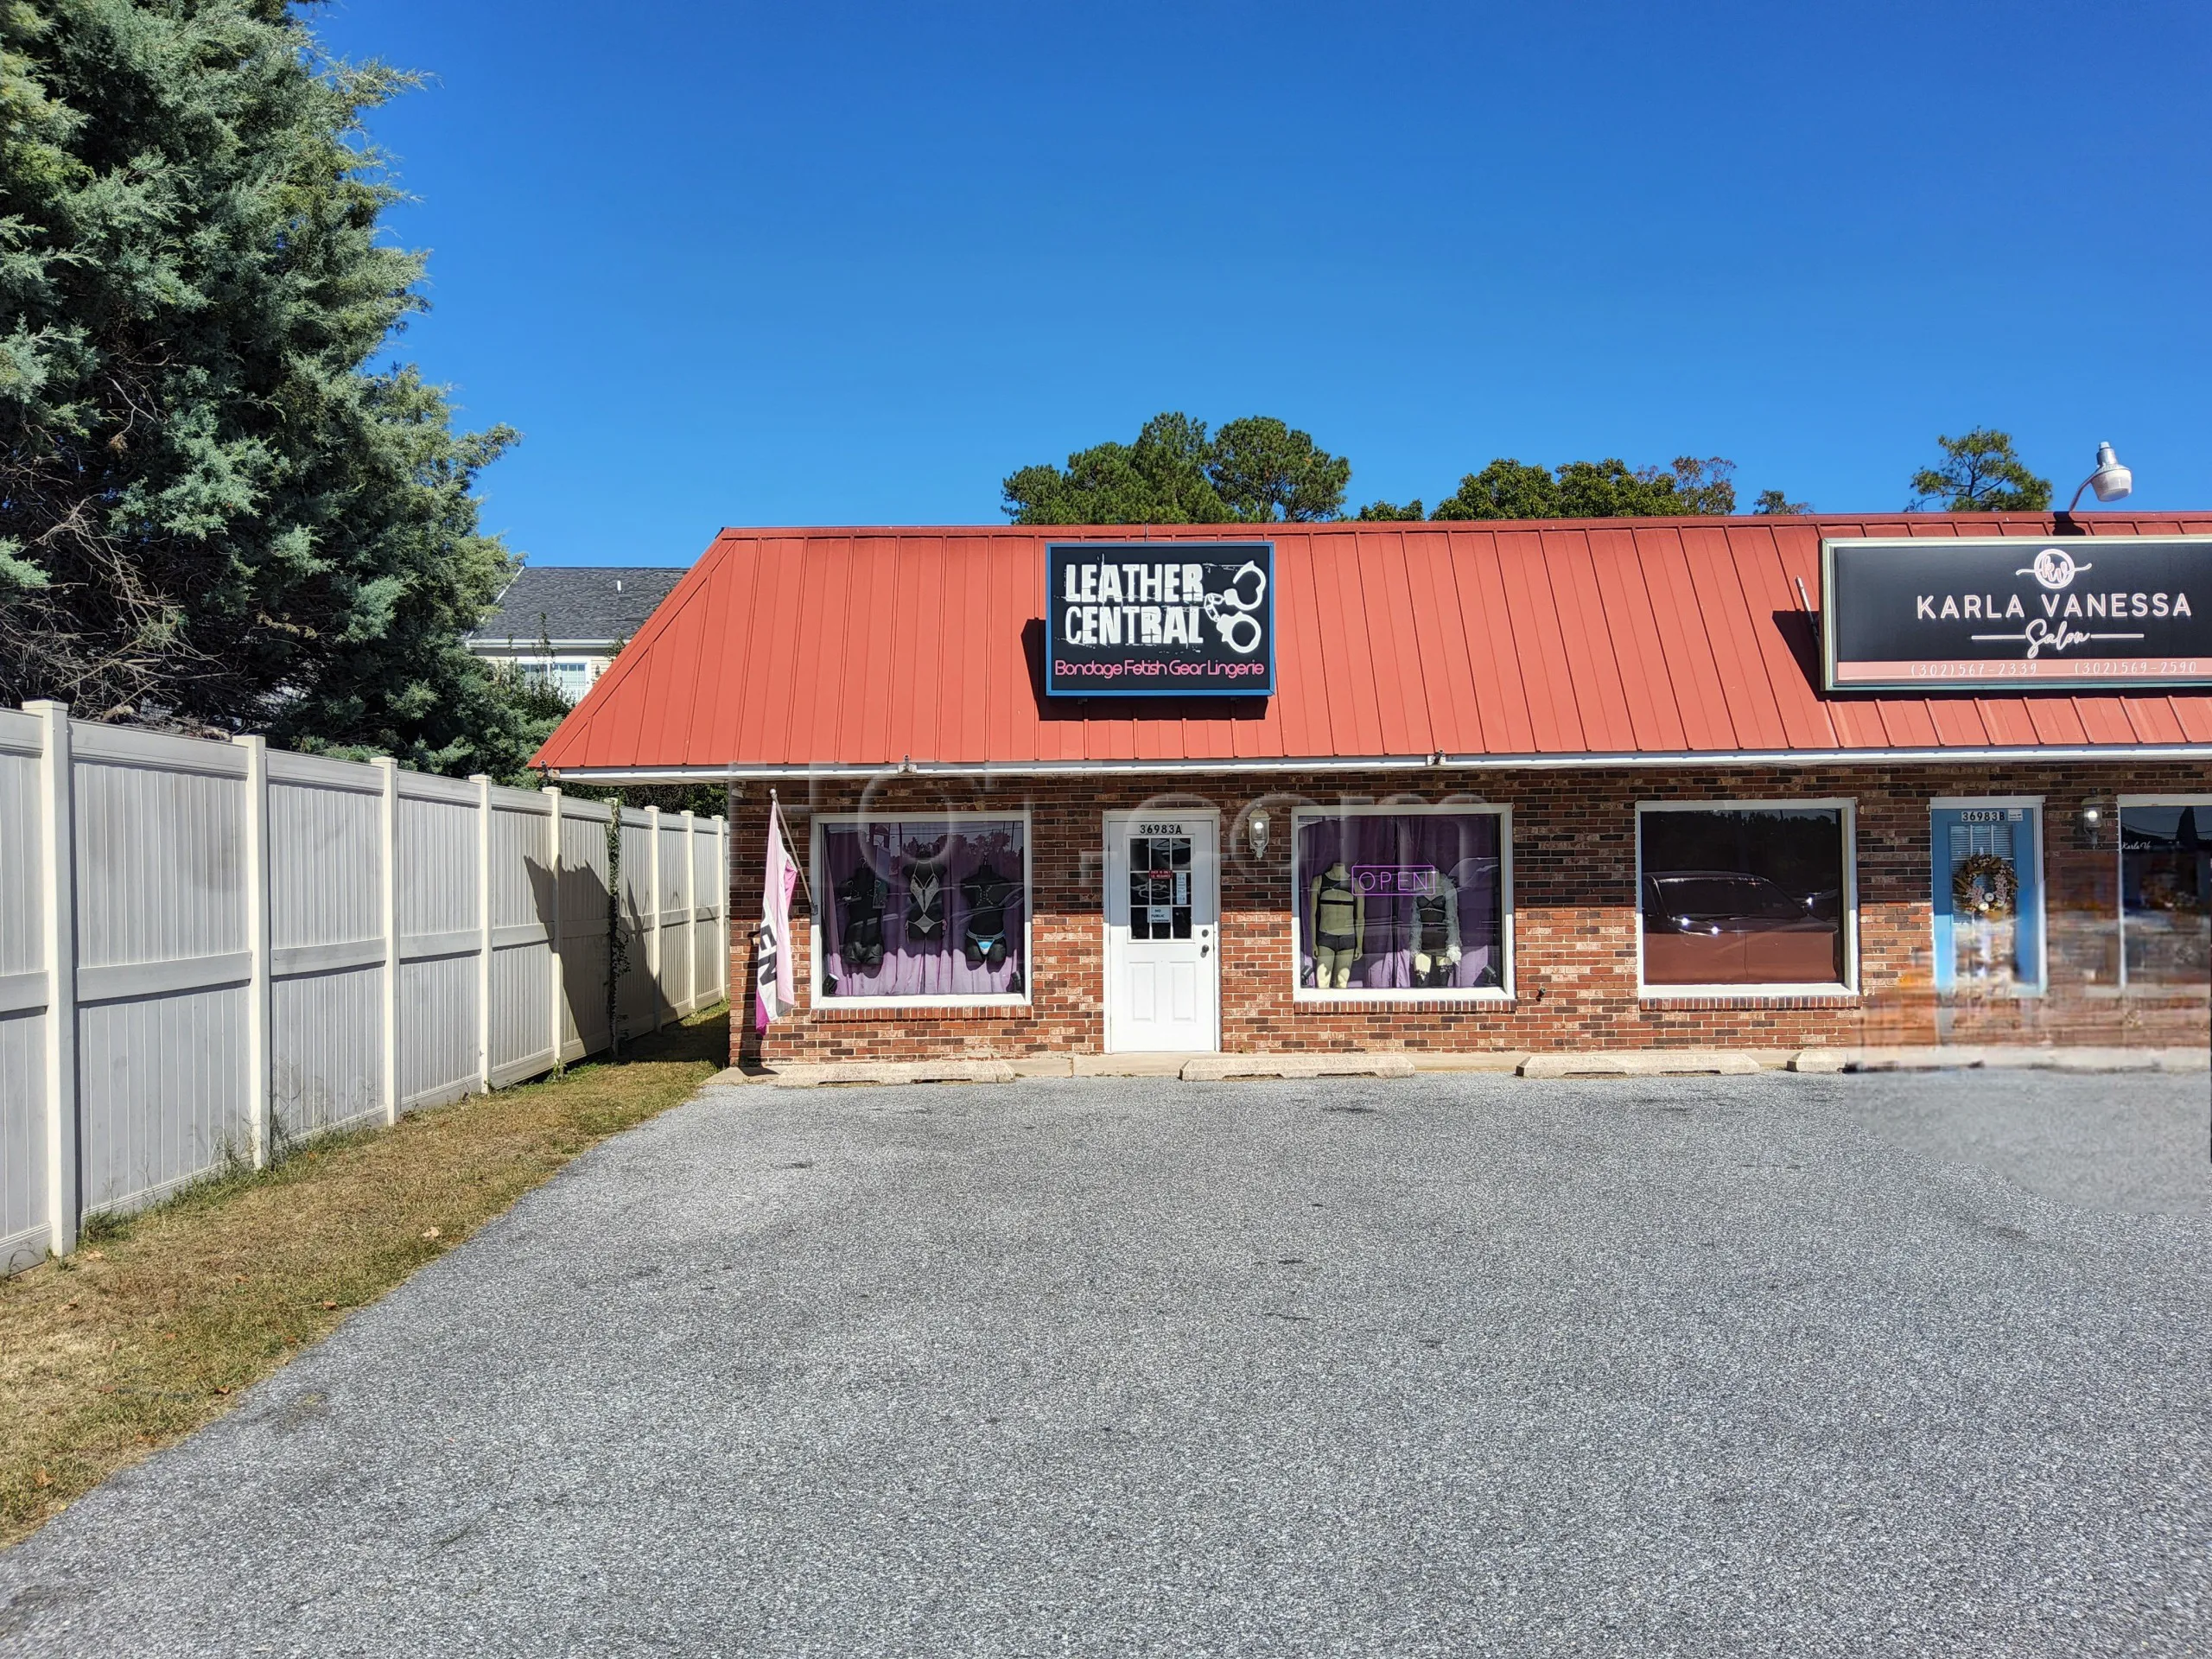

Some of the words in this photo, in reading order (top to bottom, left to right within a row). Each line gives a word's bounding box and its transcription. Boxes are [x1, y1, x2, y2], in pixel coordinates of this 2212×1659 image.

[1065, 563, 1204, 602] LEATHER
[1916, 594, 2025, 619] KARLA
[2041, 593, 2192, 617] VANESSA
[1065, 607, 1204, 645] CENTRAL
[2025, 619, 2091, 659] Salon
[1054, 659, 1123, 678] Bondage
[1123, 659, 1167, 676] Fetish
[1169, 659, 1207, 676] Gear
[1207, 659, 1265, 678] Lingerie
[1139, 823, 1183, 835] 36983A
[1961, 810, 2005, 822] 36983B
[1358, 871, 1428, 891] OPEN
[758, 924, 778, 986] EN
